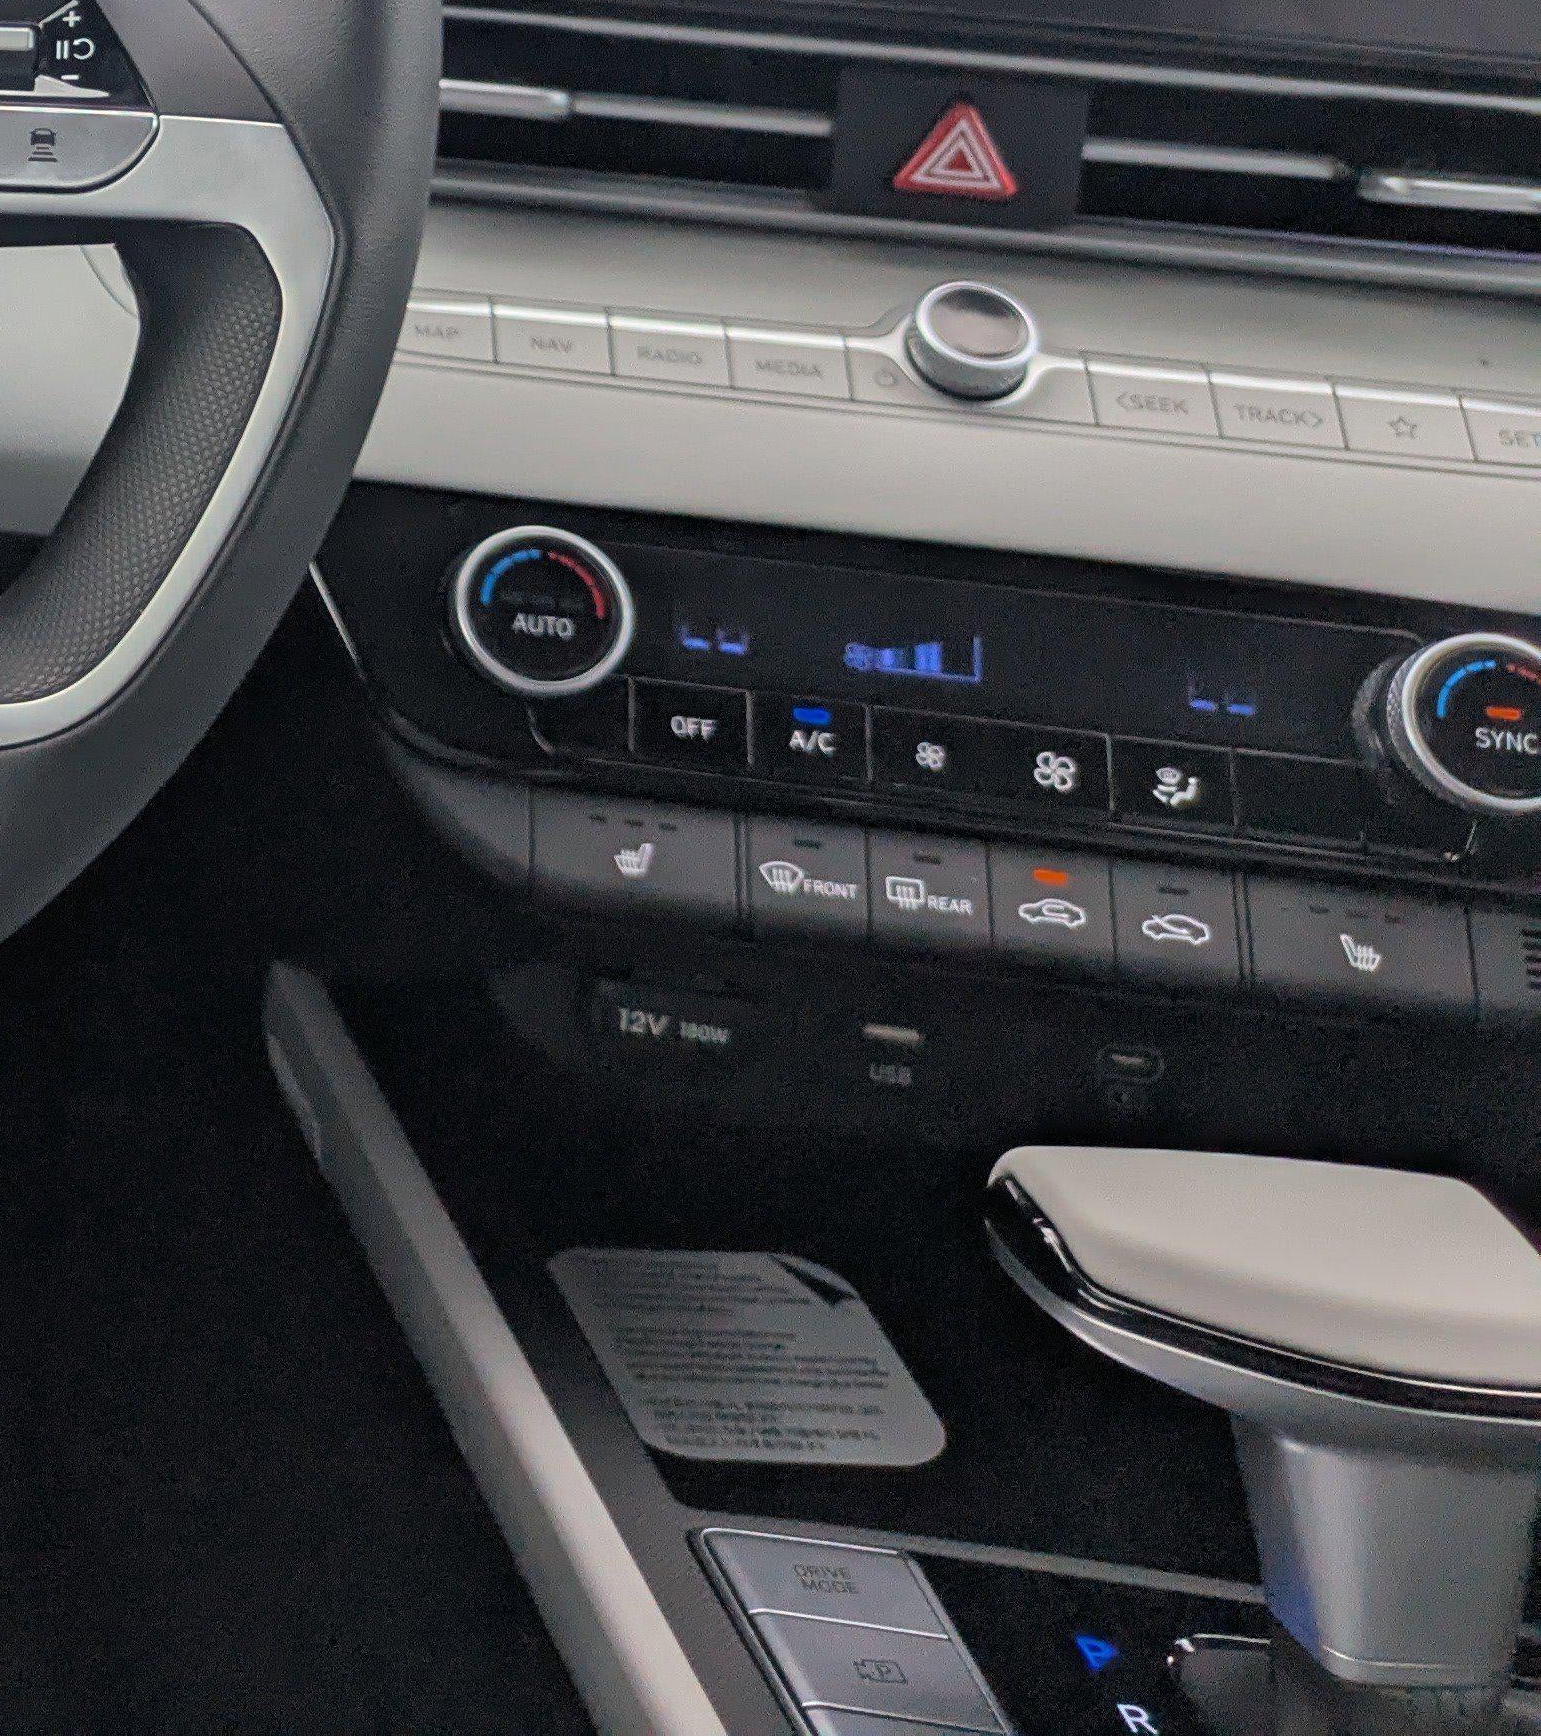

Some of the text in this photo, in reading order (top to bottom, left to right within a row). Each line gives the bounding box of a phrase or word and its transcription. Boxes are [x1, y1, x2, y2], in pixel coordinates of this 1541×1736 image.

[414, 324, 459, 338] MAP
[530, 336, 573, 353] NAV
[636, 344, 702, 365] RADIO
[755, 359, 823, 379] MEDIA
[512, 612, 576, 640] AUTO
[670, 716, 716, 739] OFF
[789, 729, 836, 756] A/C
[803, 879, 858, 900] FRONT
[927, 895, 973, 915] REAR
[618, 1007, 670, 1037] 12V
[793, 1563, 851, 1580] DRIVE
[1075, 1634, 1116, 1671] P
[1118, 1704, 1158, 1734] R
